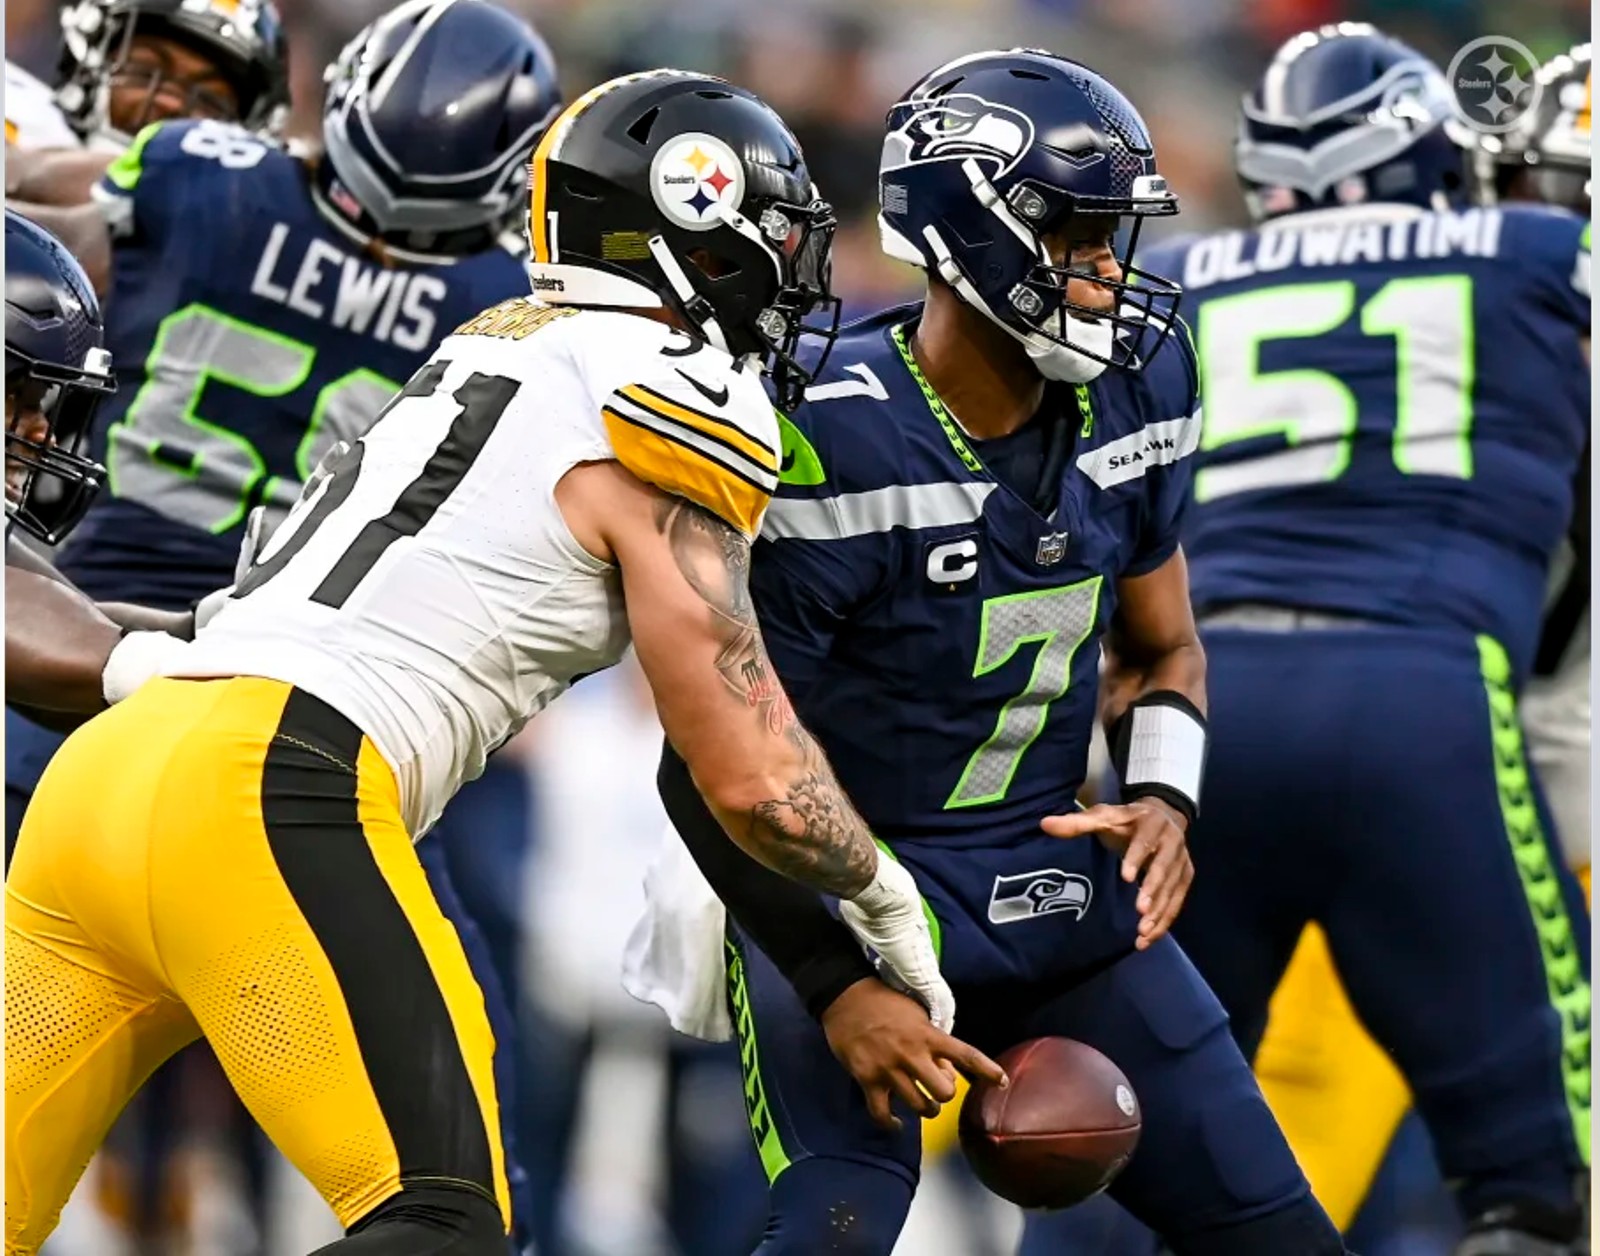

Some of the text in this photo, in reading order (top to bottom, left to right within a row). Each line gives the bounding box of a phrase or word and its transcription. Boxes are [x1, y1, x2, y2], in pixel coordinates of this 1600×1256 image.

[250, 222, 447, 352] LEWIS
[1183, 209, 1500, 289] OLUWATIMI
[803, 362, 890, 403] 7
[1195, 273, 1474, 503] 51
[926, 539, 978, 584] C
[943, 574, 1104, 810] 7
